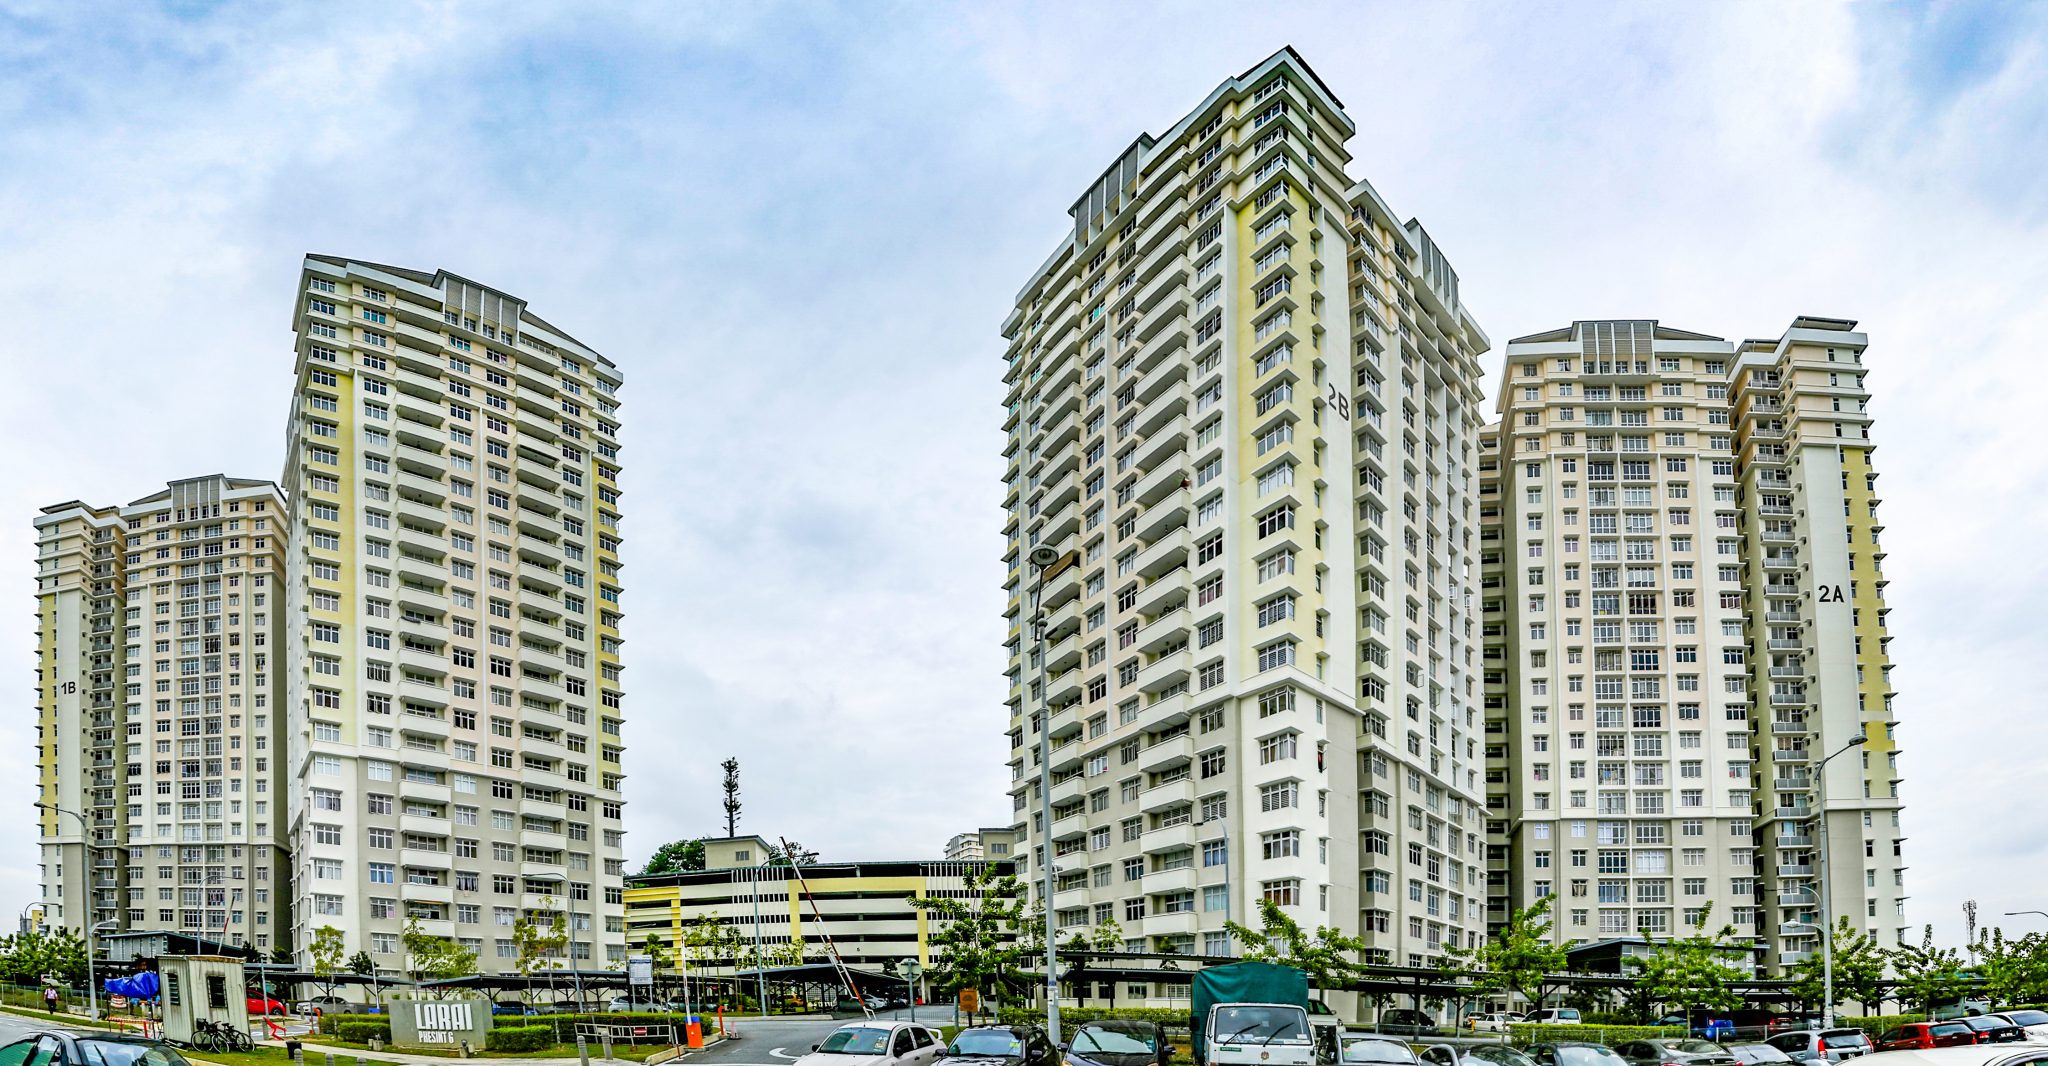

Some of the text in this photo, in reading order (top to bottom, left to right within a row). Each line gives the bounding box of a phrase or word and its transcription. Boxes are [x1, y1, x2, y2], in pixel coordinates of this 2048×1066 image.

[1328, 382, 1349, 421] 2B
[1818, 584, 1845, 603] 2A
[61, 681, 76, 695] 1B
[414, 1003, 473, 1031] LARAI
[448, 1031, 455, 1044] 6
